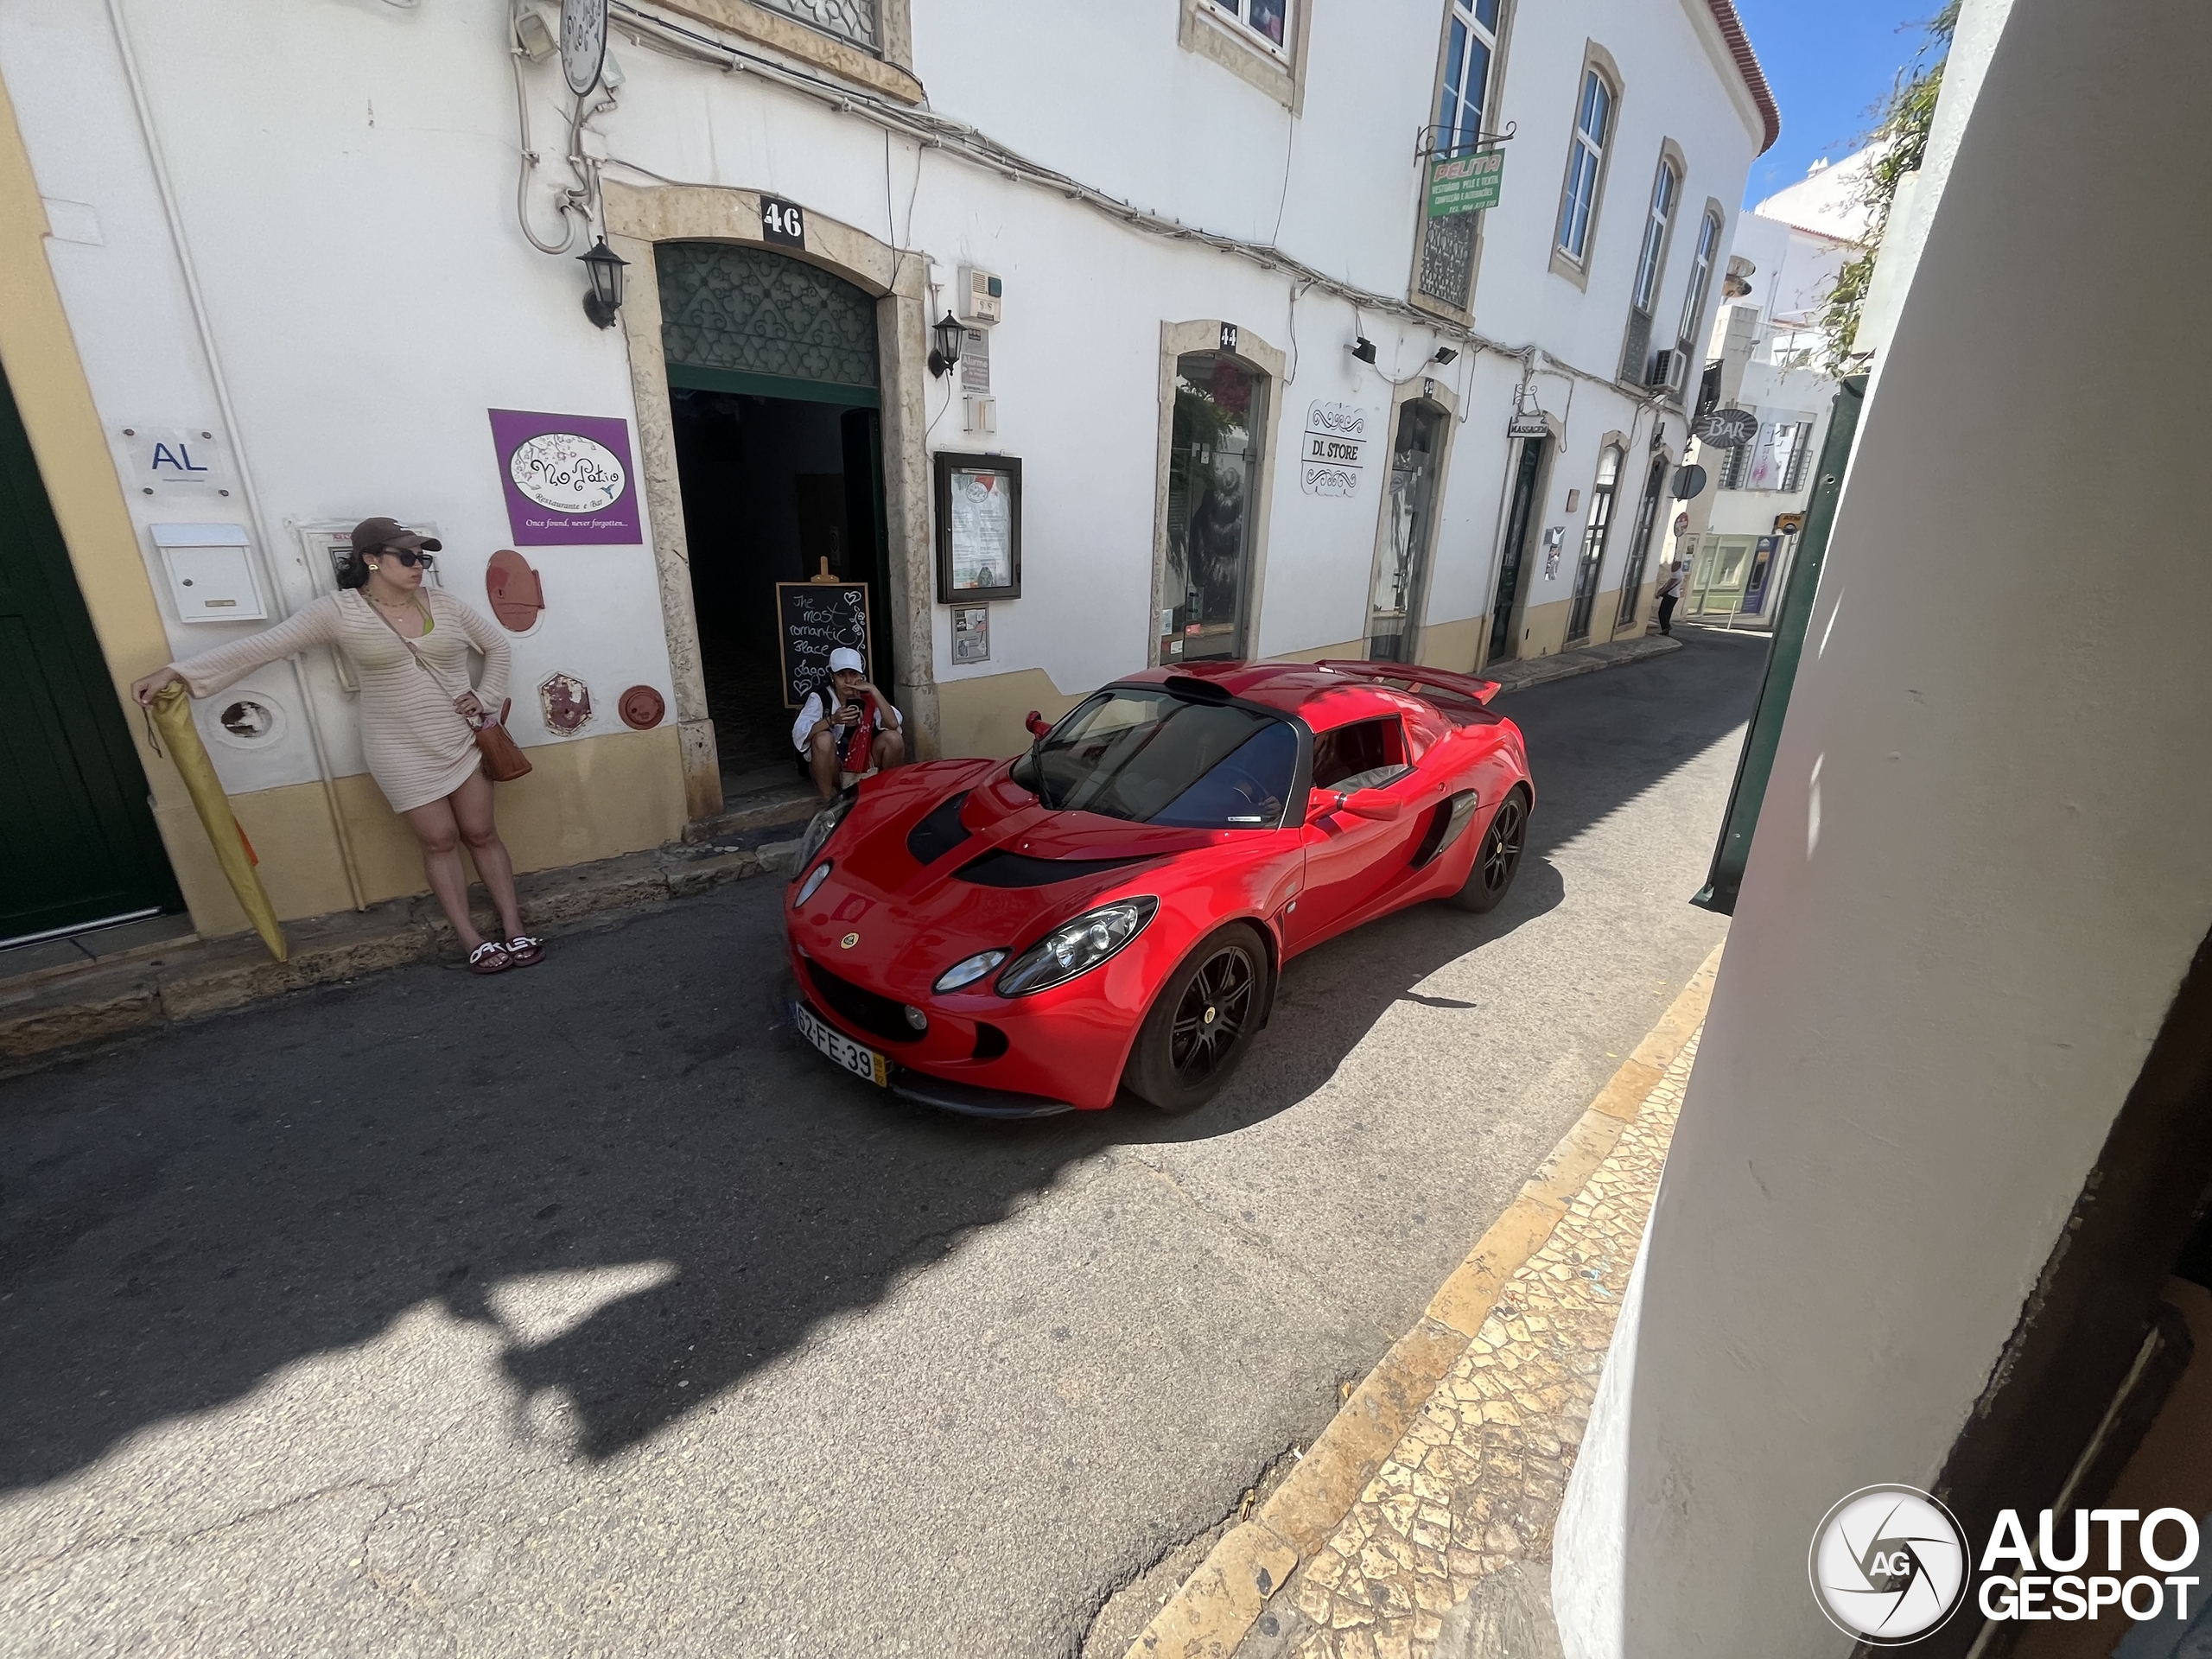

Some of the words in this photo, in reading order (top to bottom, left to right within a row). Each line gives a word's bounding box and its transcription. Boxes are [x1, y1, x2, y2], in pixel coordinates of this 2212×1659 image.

[1433, 155, 1501, 182] PELITA
[1463, 179, 1475, 188] PELE
[1477, 178, 1480, 187] E
[764, 203, 802, 238] 46
[1221, 327, 1236, 346] 44
[963, 354, 988, 368] Alarme
[1425, 380, 1433, 394] 42
[1703, 416, 1745, 439] BAR
[152, 442, 208, 471] AL
[1327, 442, 1358, 461] STORE
[535, 493, 580, 510] Restaurante
[590, 499, 603, 508] Bar
[544, 518, 569, 529] found,
[793, 594, 815, 609] The
[804, 602, 848, 627] most
[790, 626, 858, 645] romantic
